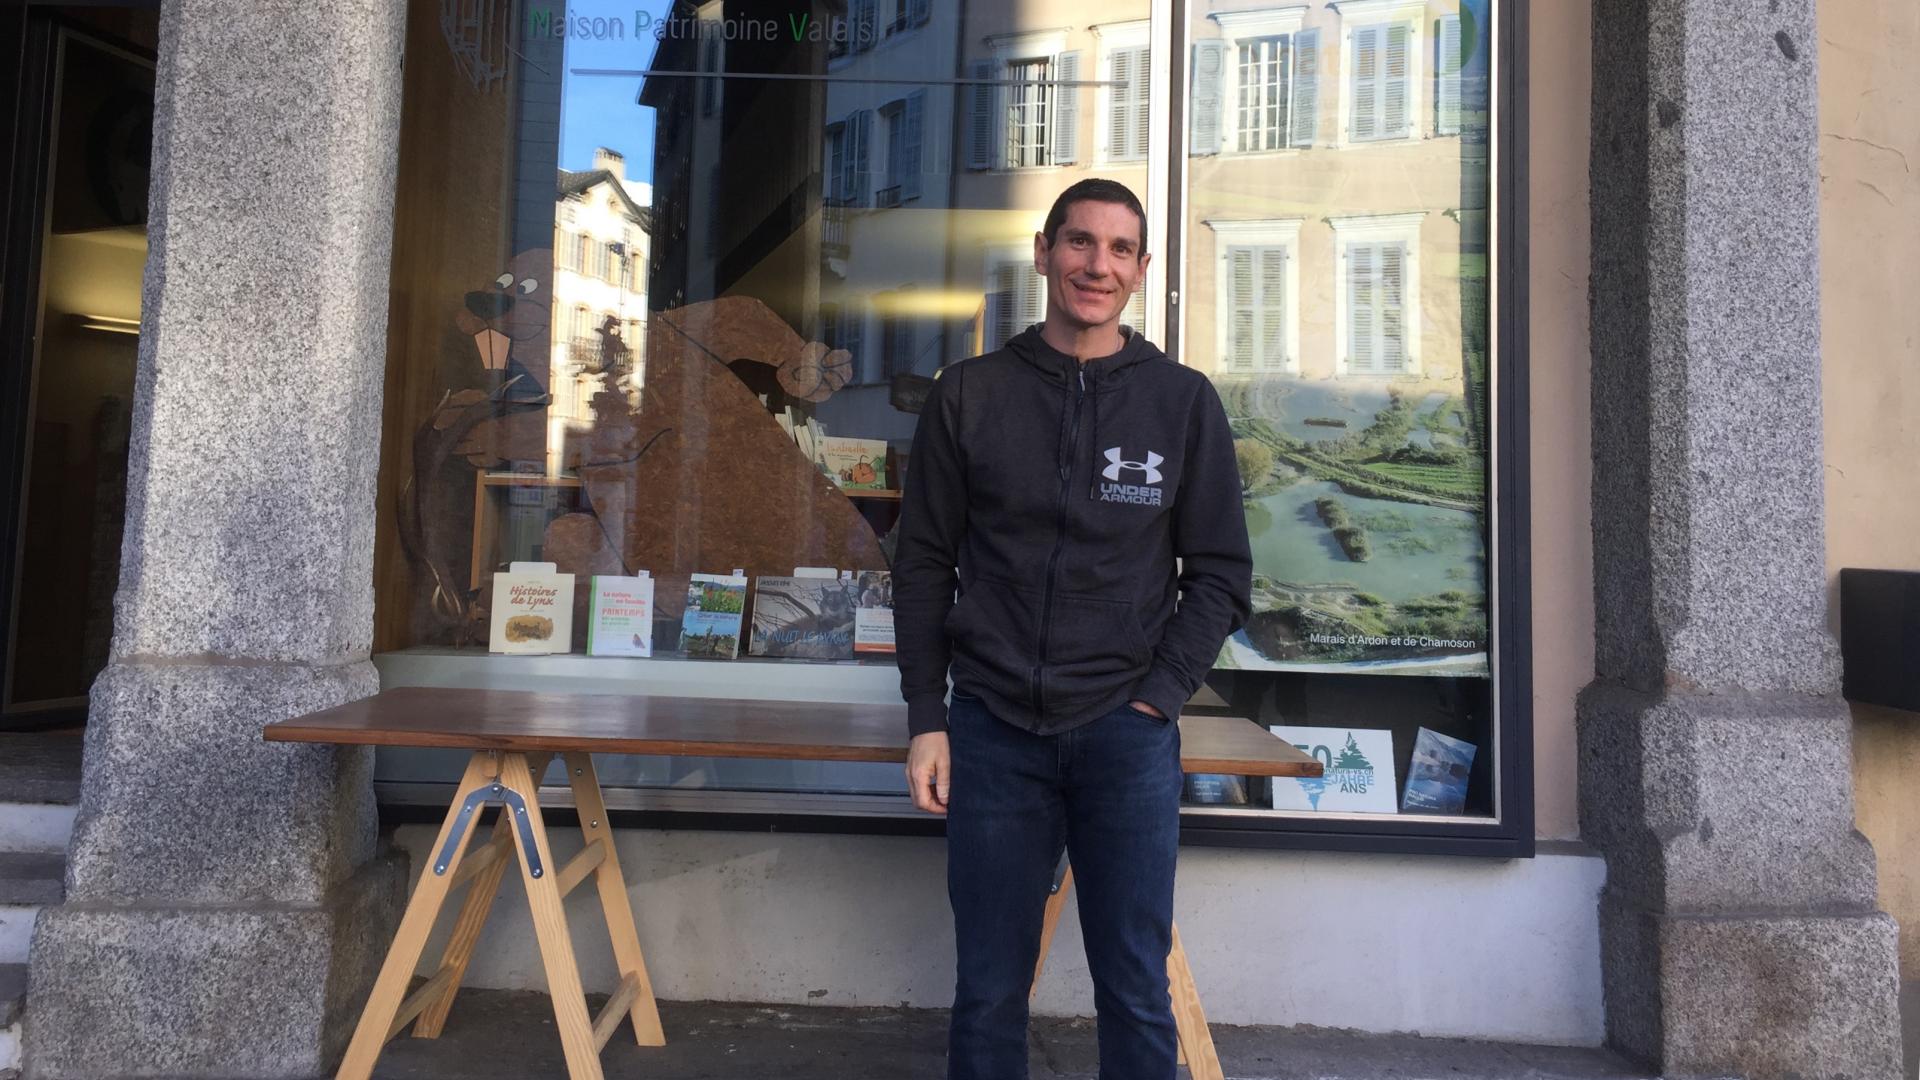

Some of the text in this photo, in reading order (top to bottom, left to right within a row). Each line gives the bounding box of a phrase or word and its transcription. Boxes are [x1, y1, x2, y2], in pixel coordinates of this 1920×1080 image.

[530, 9, 872, 43] Maison Patrimoine Valais
[1100, 482, 1162, 498] UNDER
[1100, 493, 1161, 506] ARMOUR
[510, 585, 558, 599] Histoires
[511, 596, 554, 610] de Lynx
[1310, 633, 1476, 649] Marais d'Ardon et de Chamoson
[1293, 744, 1332, 768] 0
[1331, 774, 1374, 785] JAHRE
[1340, 783, 1367, 794] ANS
